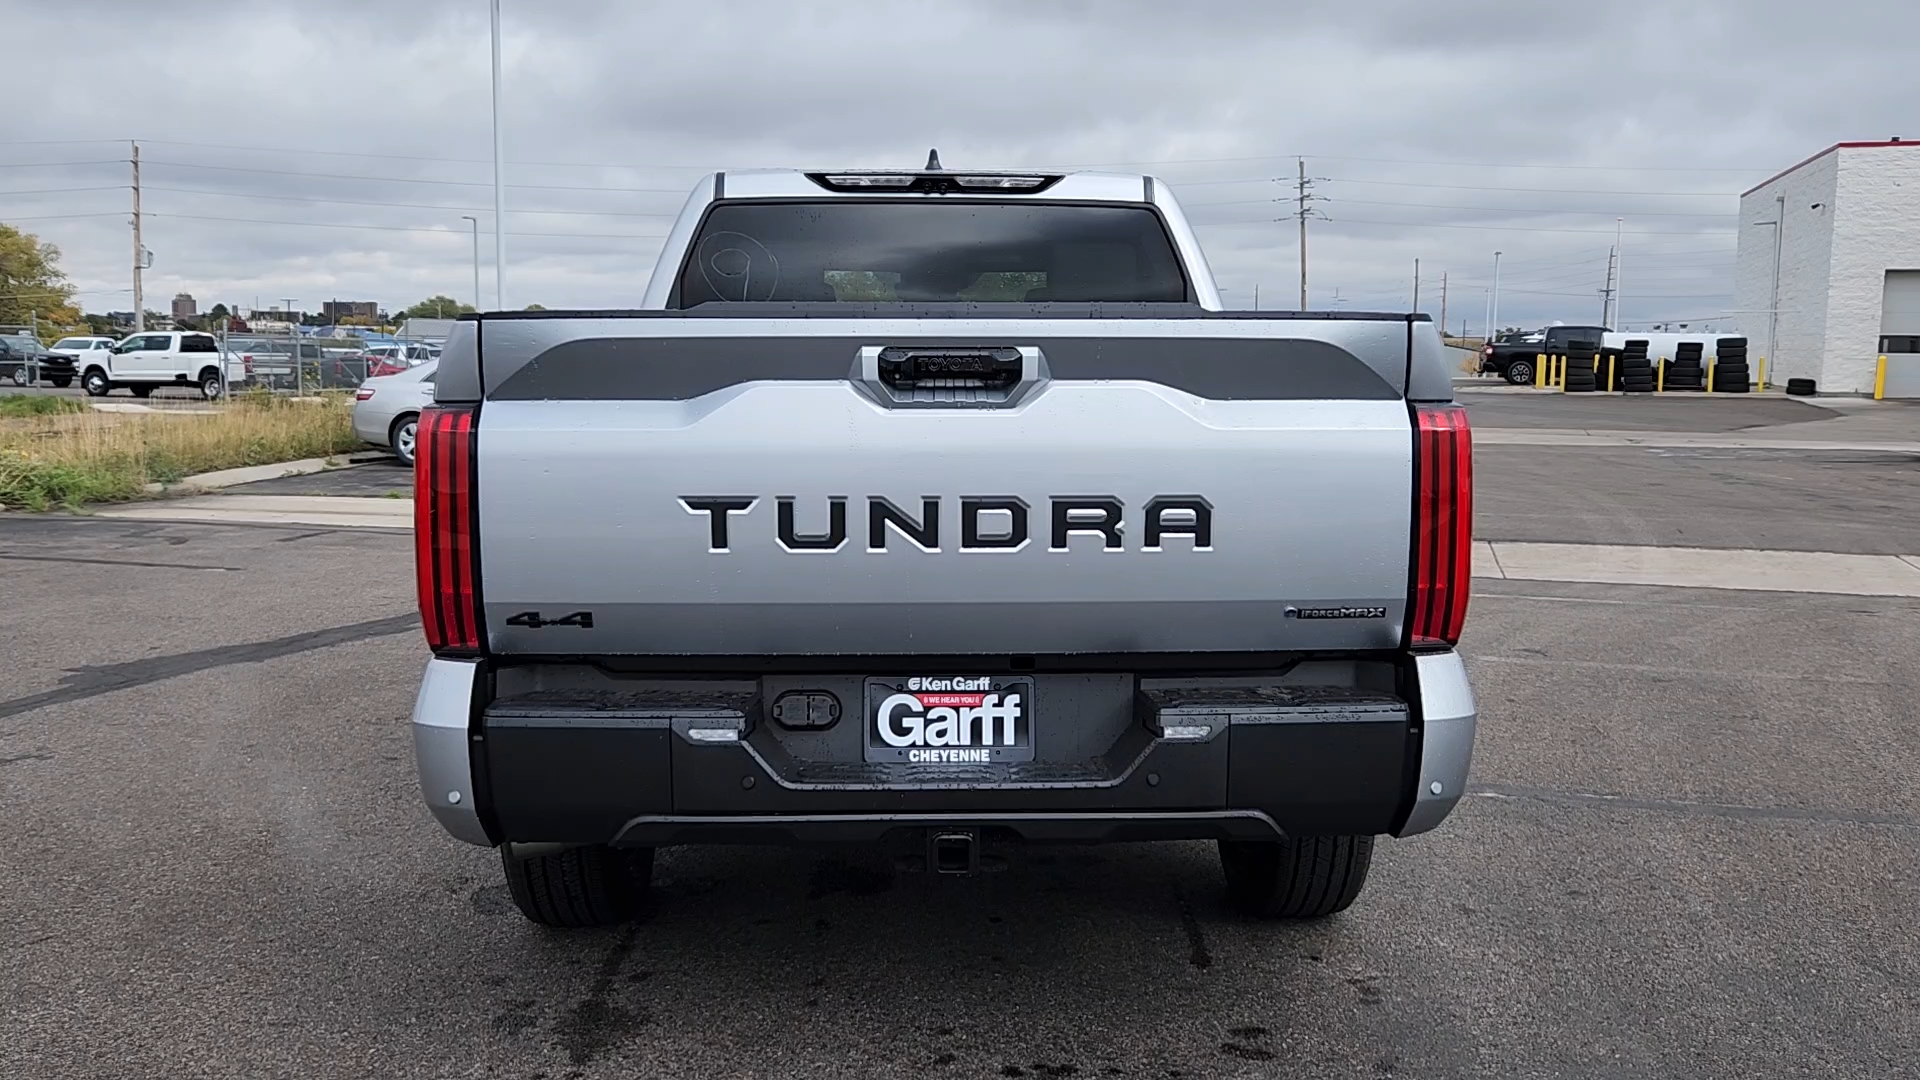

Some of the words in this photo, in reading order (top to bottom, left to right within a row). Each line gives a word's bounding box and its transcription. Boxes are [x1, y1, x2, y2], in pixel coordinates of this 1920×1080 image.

[917, 357, 984, 371] TOYOTA
[676, 495, 1215, 554] TUNDRA
[921, 677, 951, 691] Ken
[952, 676, 991, 691] Garff
[928, 696, 941, 704] WE
[941, 696, 960, 704] HEAR
[960, 696, 975, 704] YOU
[877, 693, 1021, 747] Garff
[909, 749, 990, 762] CHEYENNE
